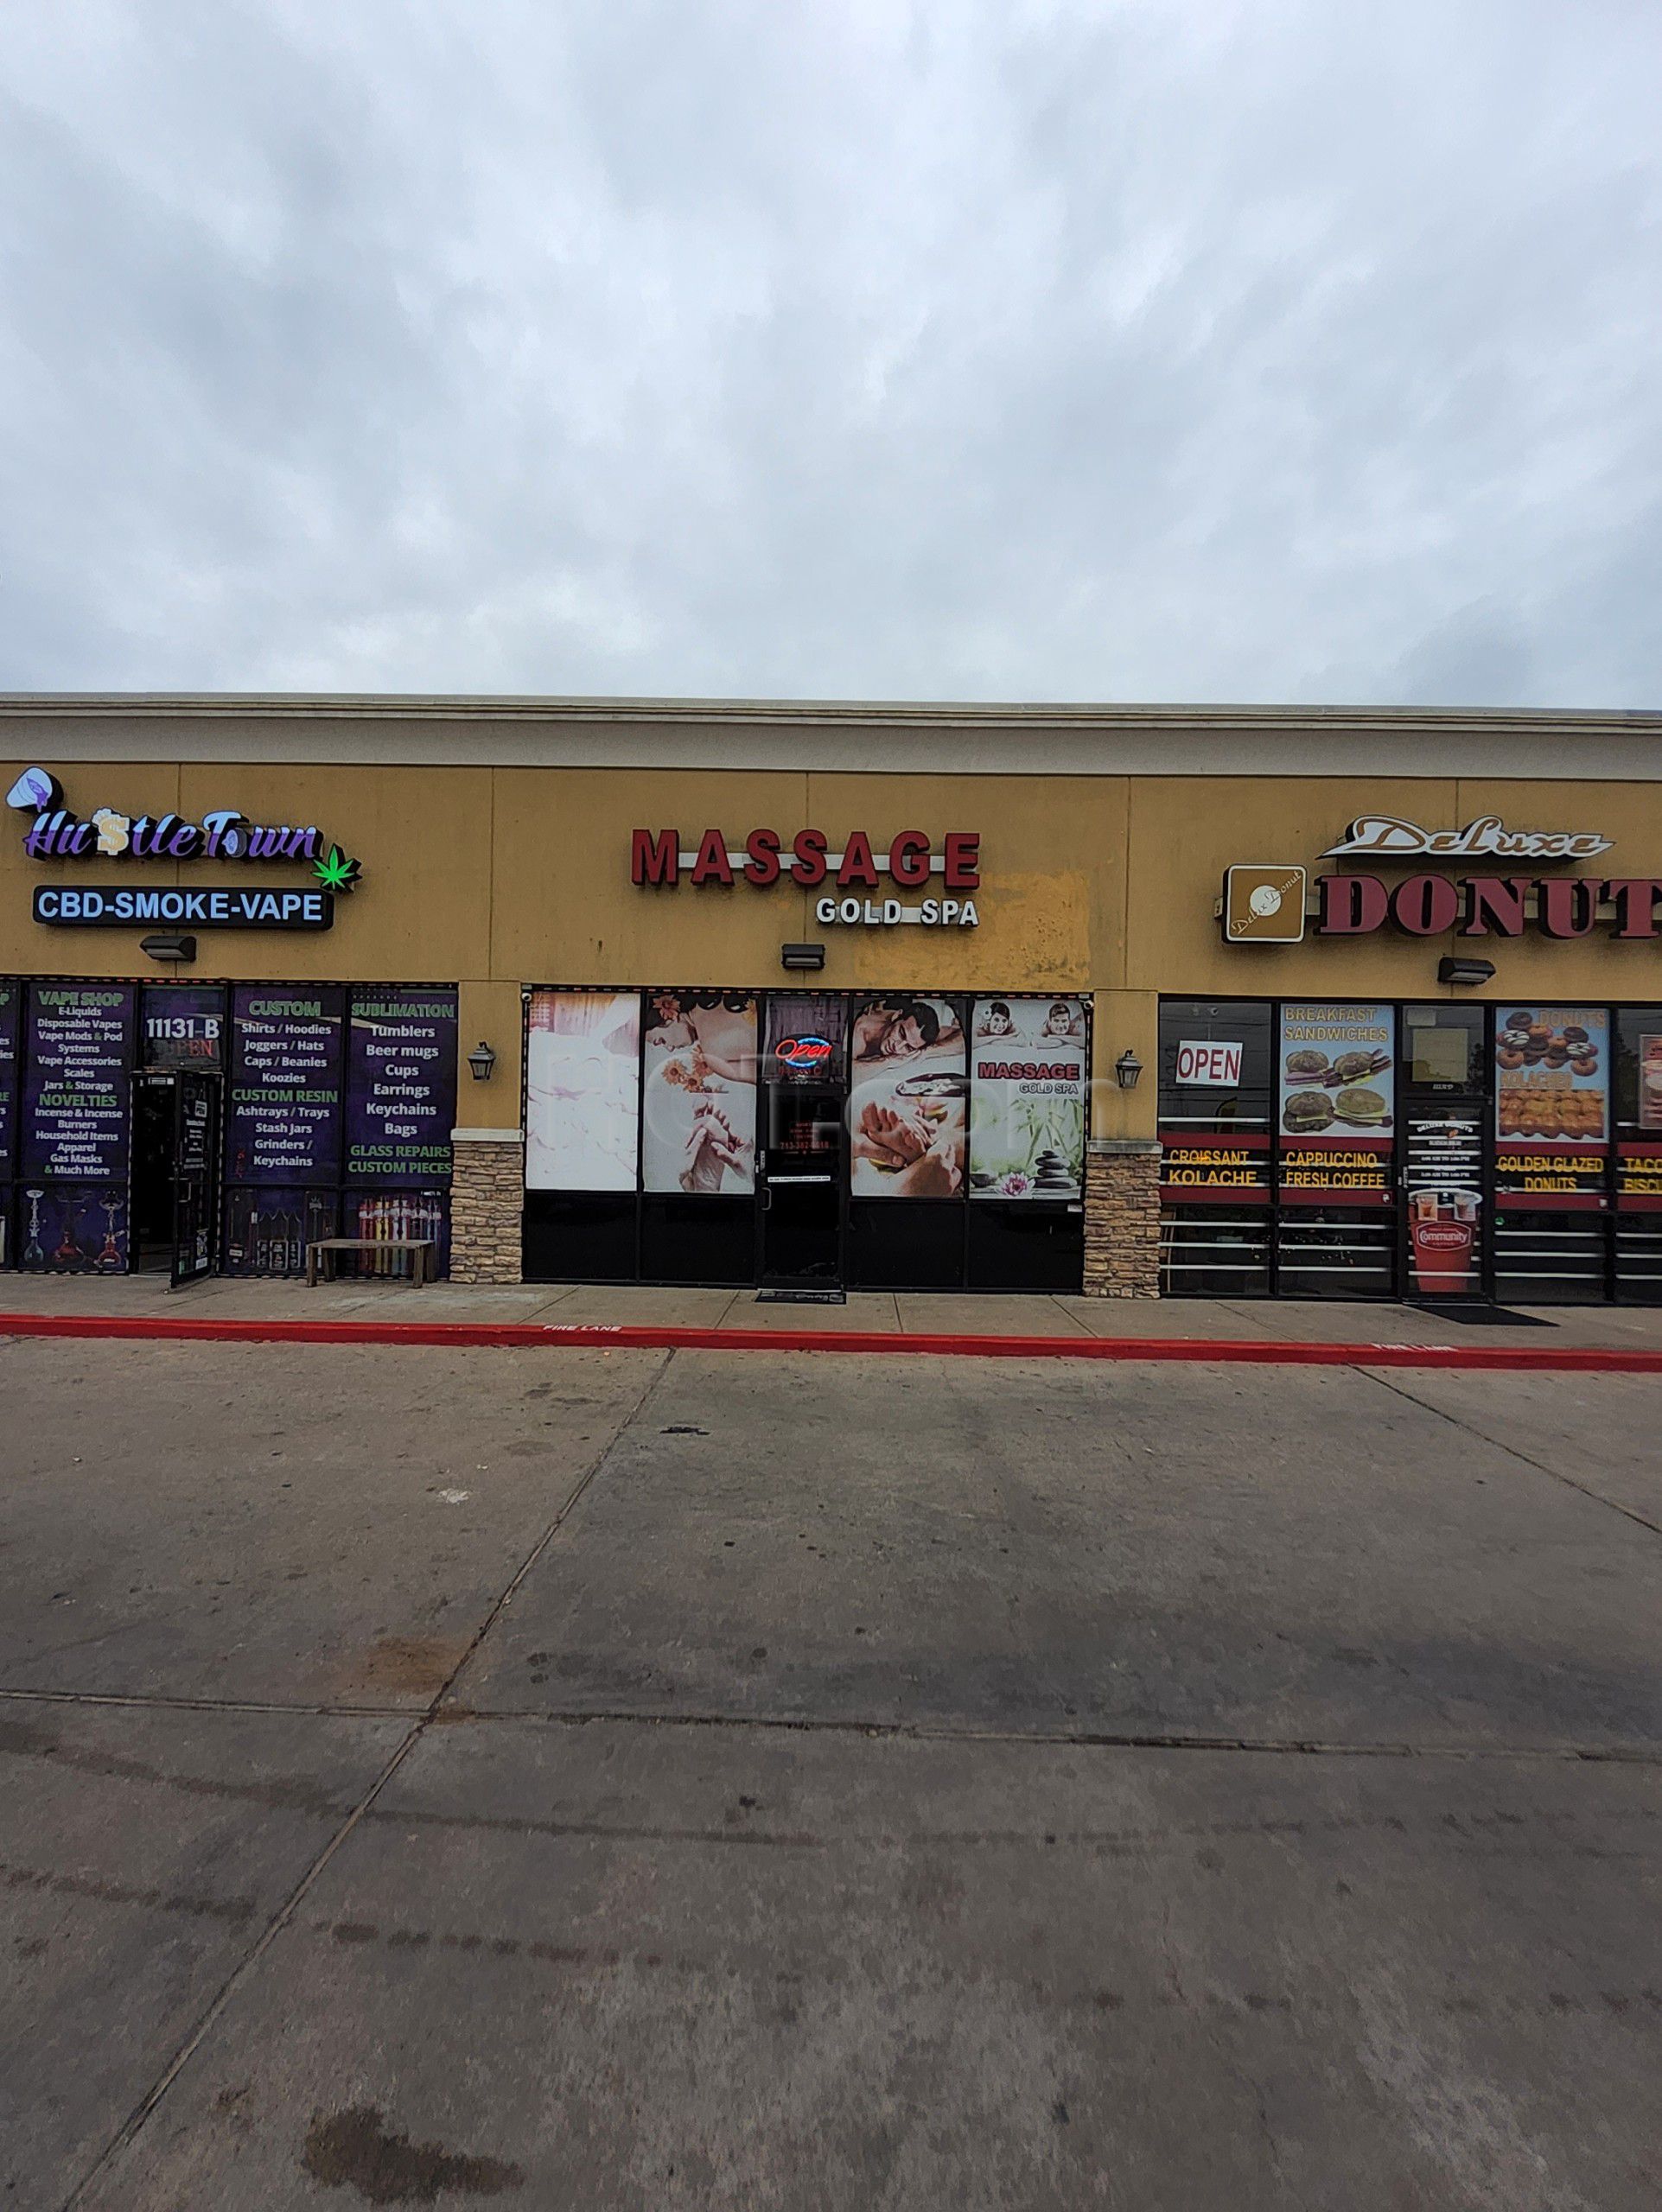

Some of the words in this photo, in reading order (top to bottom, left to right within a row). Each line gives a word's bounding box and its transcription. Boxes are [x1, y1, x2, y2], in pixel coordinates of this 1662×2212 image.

[632, 830, 979, 887] MASSAGE
[38, 892, 322, 921] CBD-SMOKE-VAPE
[816, 898, 902, 925] GOLD
[920, 899, 979, 926] SPA
[38, 991, 80, 1005] VAPE
[80, 992, 124, 1007] SHOP
[58, 1007, 102, 1018] E-Liquids
[248, 1001, 321, 1016] CUSTOM
[351, 1002, 455, 1018] SUBLIMATION
[1284, 1007, 1376, 1021] BREAKFAST
[37, 1019, 90, 1030] Disposable
[92, 1020, 123, 1031] Vapes
[1538, 1010, 1606, 1028] DONUTS
[147, 1018, 220, 1039] 11131-B
[241, 1023, 276, 1033] Shirts
[285, 1024, 332, 1034] Hoodies
[370, 1025, 436, 1037] Tumblers
[1284, 1026, 1388, 1042] SANDWICHES
[38, 1031, 63, 1042] Vape
[65, 1032, 92, 1040] Mods
[104, 1033, 123, 1041] Pod
[58, 1044, 100, 1054] Systems
[243, 1039, 288, 1052] Joggers
[297, 1040, 325, 1051] Hats
[366, 1045, 398, 1056] Beer
[400, 1046, 439, 1060] mugs
[775, 1039, 831, 1061] Open
[37, 1056, 63, 1067] Vape
[64, 1056, 122, 1066] Accessories
[244, 1056, 272, 1069] Caps
[282, 1056, 328, 1067] Beanies
[1178, 1047, 1239, 1080] OPEN
[63, 1069, 94, 1077] Scales
[262, 1072, 306, 1084] Koozies
[385, 1064, 420, 1079] Cups
[977, 1062, 1080, 1080] MASSAGE
[44, 1080, 64, 1092] Jars
[74, 1081, 113, 1093] Storage
[373, 1083, 430, 1098] Earrings
[1019, 1082, 1053, 1094] GOLD
[1054, 1083, 1079, 1095] SPA
[39, 1094, 118, 1107] NOVELTIES
[232, 1089, 293, 1102] CUSTOM
[296, 1090, 338, 1103] RESIN
[35, 1108, 73, 1117] Incense
[74, 1109, 83, 1117] &
[85, 1109, 124, 1118] Incense
[236, 1106, 289, 1119] Ashtrays
[297, 1107, 330, 1120] Trays
[366, 1103, 436, 1118] Keychains
[58, 1120, 97, 1129] Burners
[255, 1122, 288, 1133] Stash
[288, 1123, 312, 1136] Jars
[385, 1122, 418, 1138] Bags
[35, 1130, 88, 1141] Household
[90, 1132, 118, 1141] Items
[57, 1142, 96, 1154] Apparel
[254, 1139, 304, 1149] Grinders
[350, 1145, 393, 1157] GLASS
[395, 1146, 451, 1157] REPAIRS
[50, 1154, 69, 1163] Gas
[70, 1154, 103, 1164] Masks
[253, 1155, 313, 1168] Keychains
[1169, 1149, 1249, 1165] CROISSANT
[1286, 1151, 1377, 1167] CAPPUCCINO
[44, 1165, 52, 1173] &
[54, 1165, 82, 1174] Much
[84, 1166, 110, 1175] More
[347, 1161, 407, 1173] CUSTOM
[409, 1162, 452, 1174] PIECES
[1498, 1156, 1551, 1172] GOLDEN
[1553, 1156, 1604, 1173] GLAZED
[1168, 1169, 1257, 1186] KOLACHE
[1286, 1171, 1328, 1188] FRESH
[1332, 1173, 1385, 1190] COFFEE
[1525, 1176, 1577, 1192] DONUTS
[1419, 1229, 1468, 1243] Community
